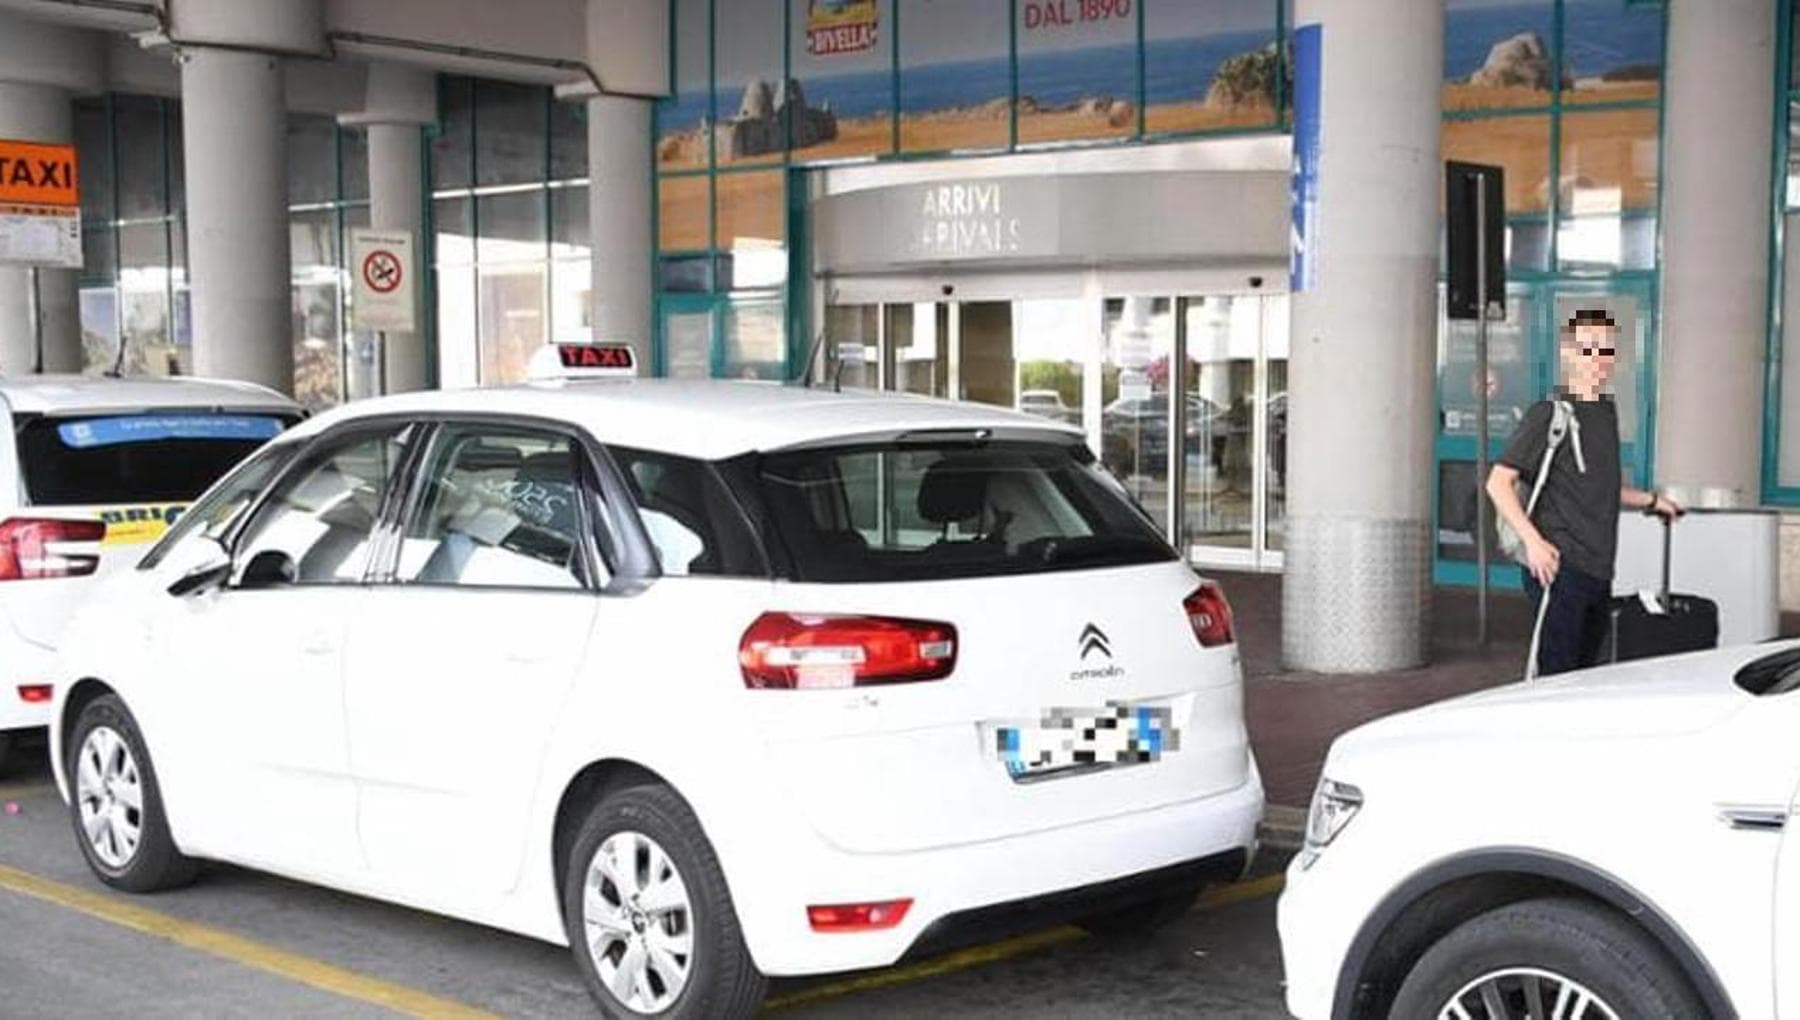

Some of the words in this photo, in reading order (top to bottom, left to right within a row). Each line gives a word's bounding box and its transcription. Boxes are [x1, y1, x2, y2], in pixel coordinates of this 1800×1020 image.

[1024, 0, 1073, 29] DAL
[922, 184, 1000, 216] ARRIVI
[565, 342, 627, 364] TAXI
